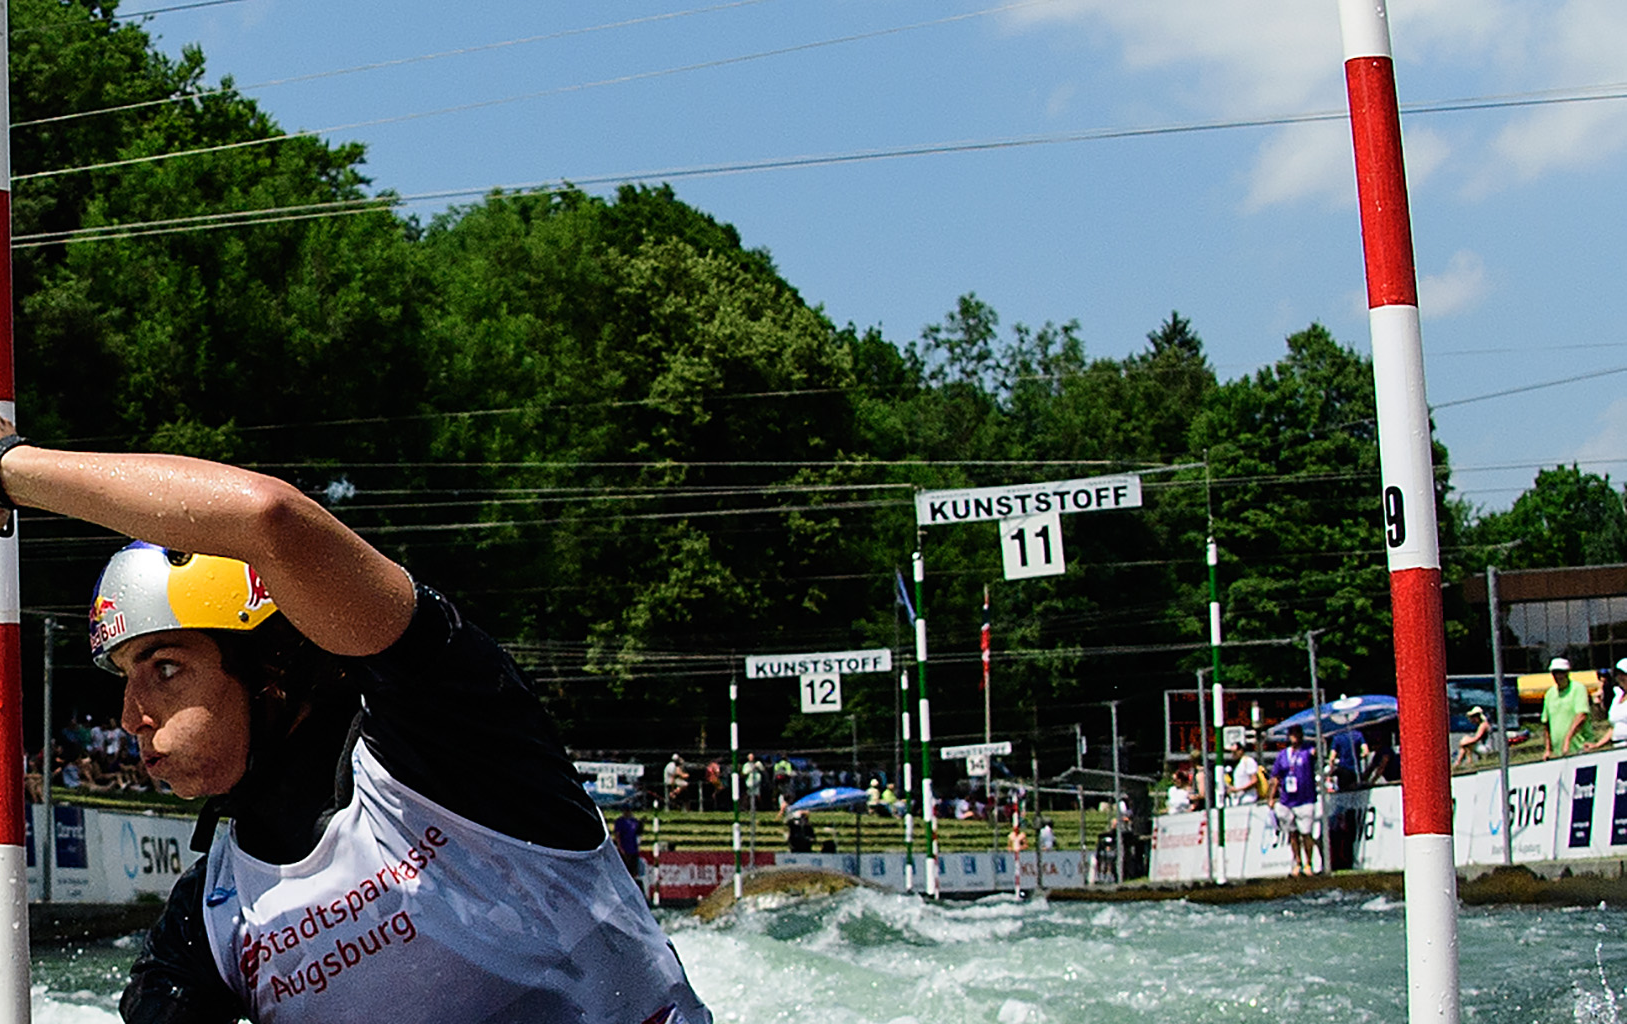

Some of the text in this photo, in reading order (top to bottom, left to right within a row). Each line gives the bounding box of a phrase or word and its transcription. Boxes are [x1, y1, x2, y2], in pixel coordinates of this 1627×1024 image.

[929, 486, 1128, 521] KUNSTSTOFF
[1385, 486, 1406, 548] 9
[1010, 525, 1053, 567] 11
[100, 613, 125, 642] Bull
[755, 656, 883, 676] KUNSTSTOFF
[805, 679, 837, 705] 12
[257, 825, 449, 963] Stadtsparkasse
[270, 911, 417, 1003] Augsburg
